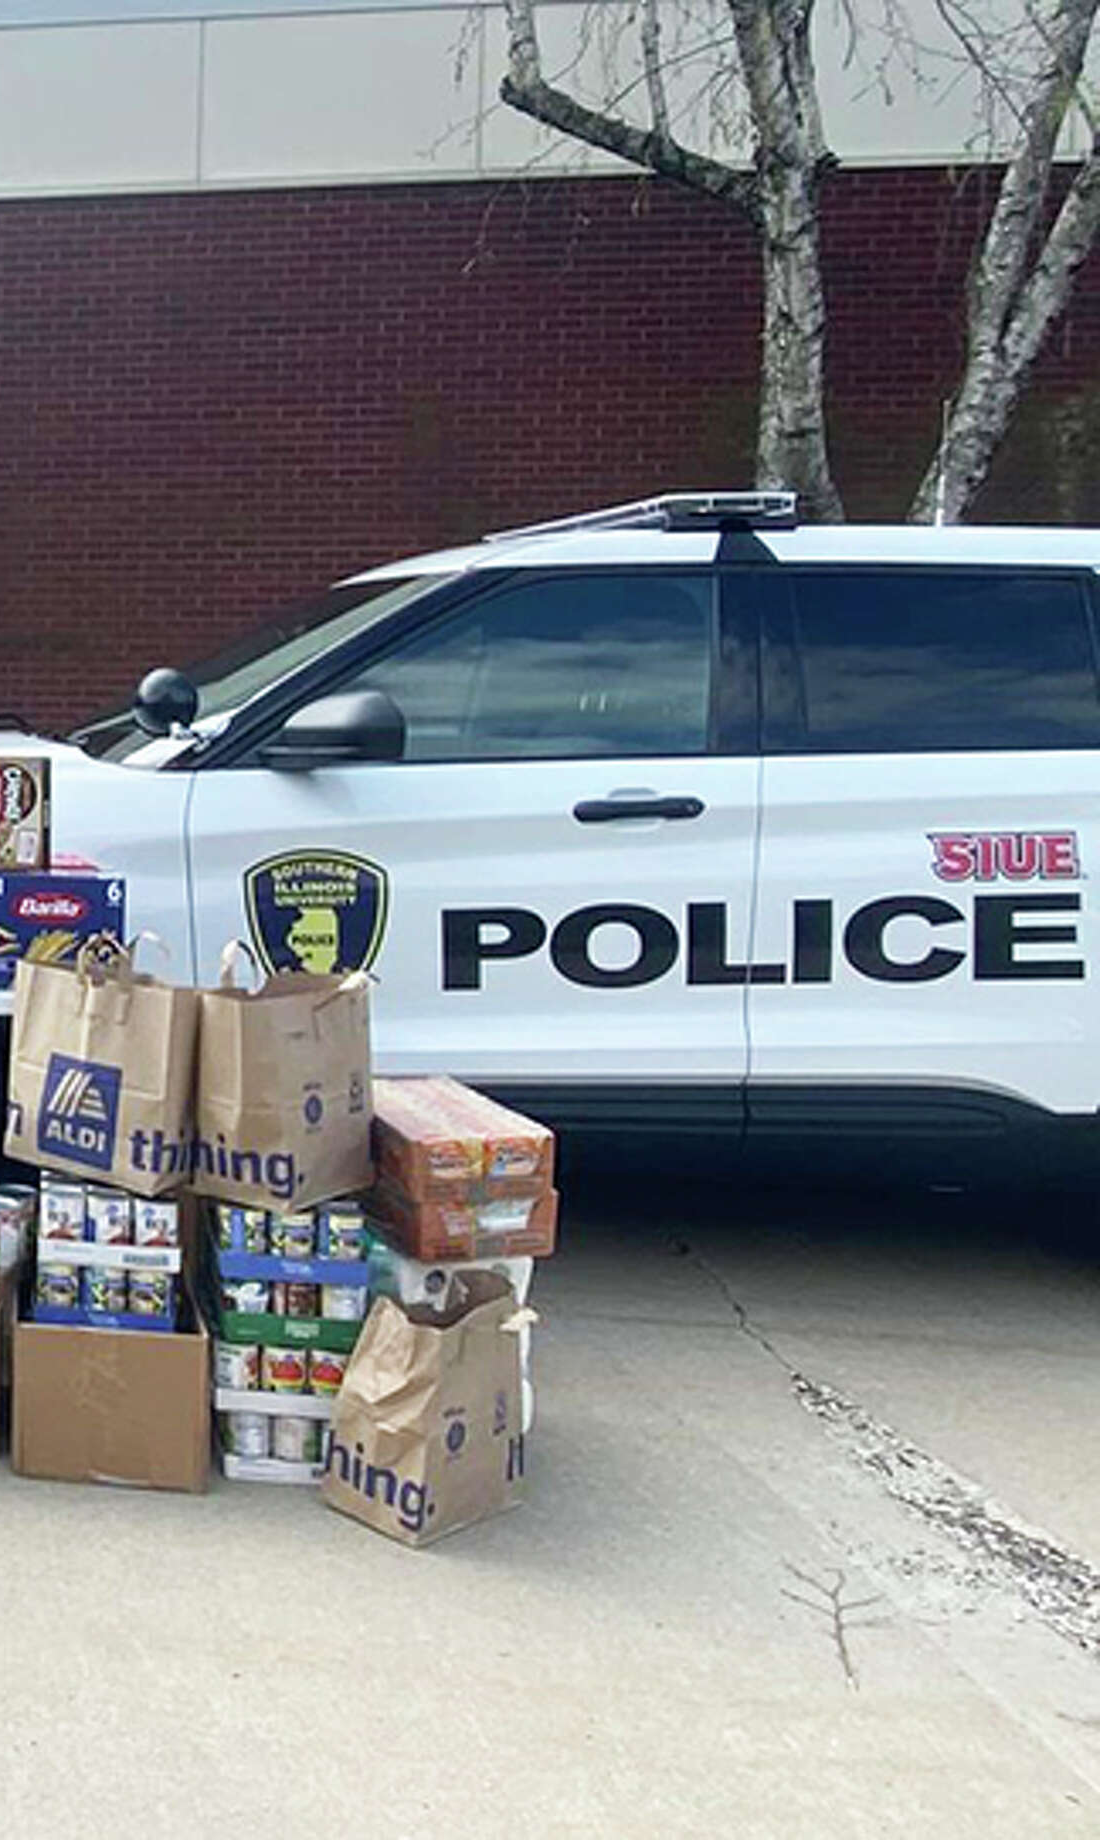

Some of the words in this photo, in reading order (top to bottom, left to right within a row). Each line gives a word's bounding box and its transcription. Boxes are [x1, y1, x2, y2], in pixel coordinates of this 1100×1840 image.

[926, 831, 1080, 882] SIUE
[271, 862, 358, 880] SOUTHERN
[106, 881, 122, 902] 6
[274, 881, 357, 894] ILLINOIS
[18, 897, 82, 917] Barilla
[291, 933, 335, 946] POLICE
[441, 892, 1085, 992] POLICE
[46, 1118, 106, 1153] ALDI
